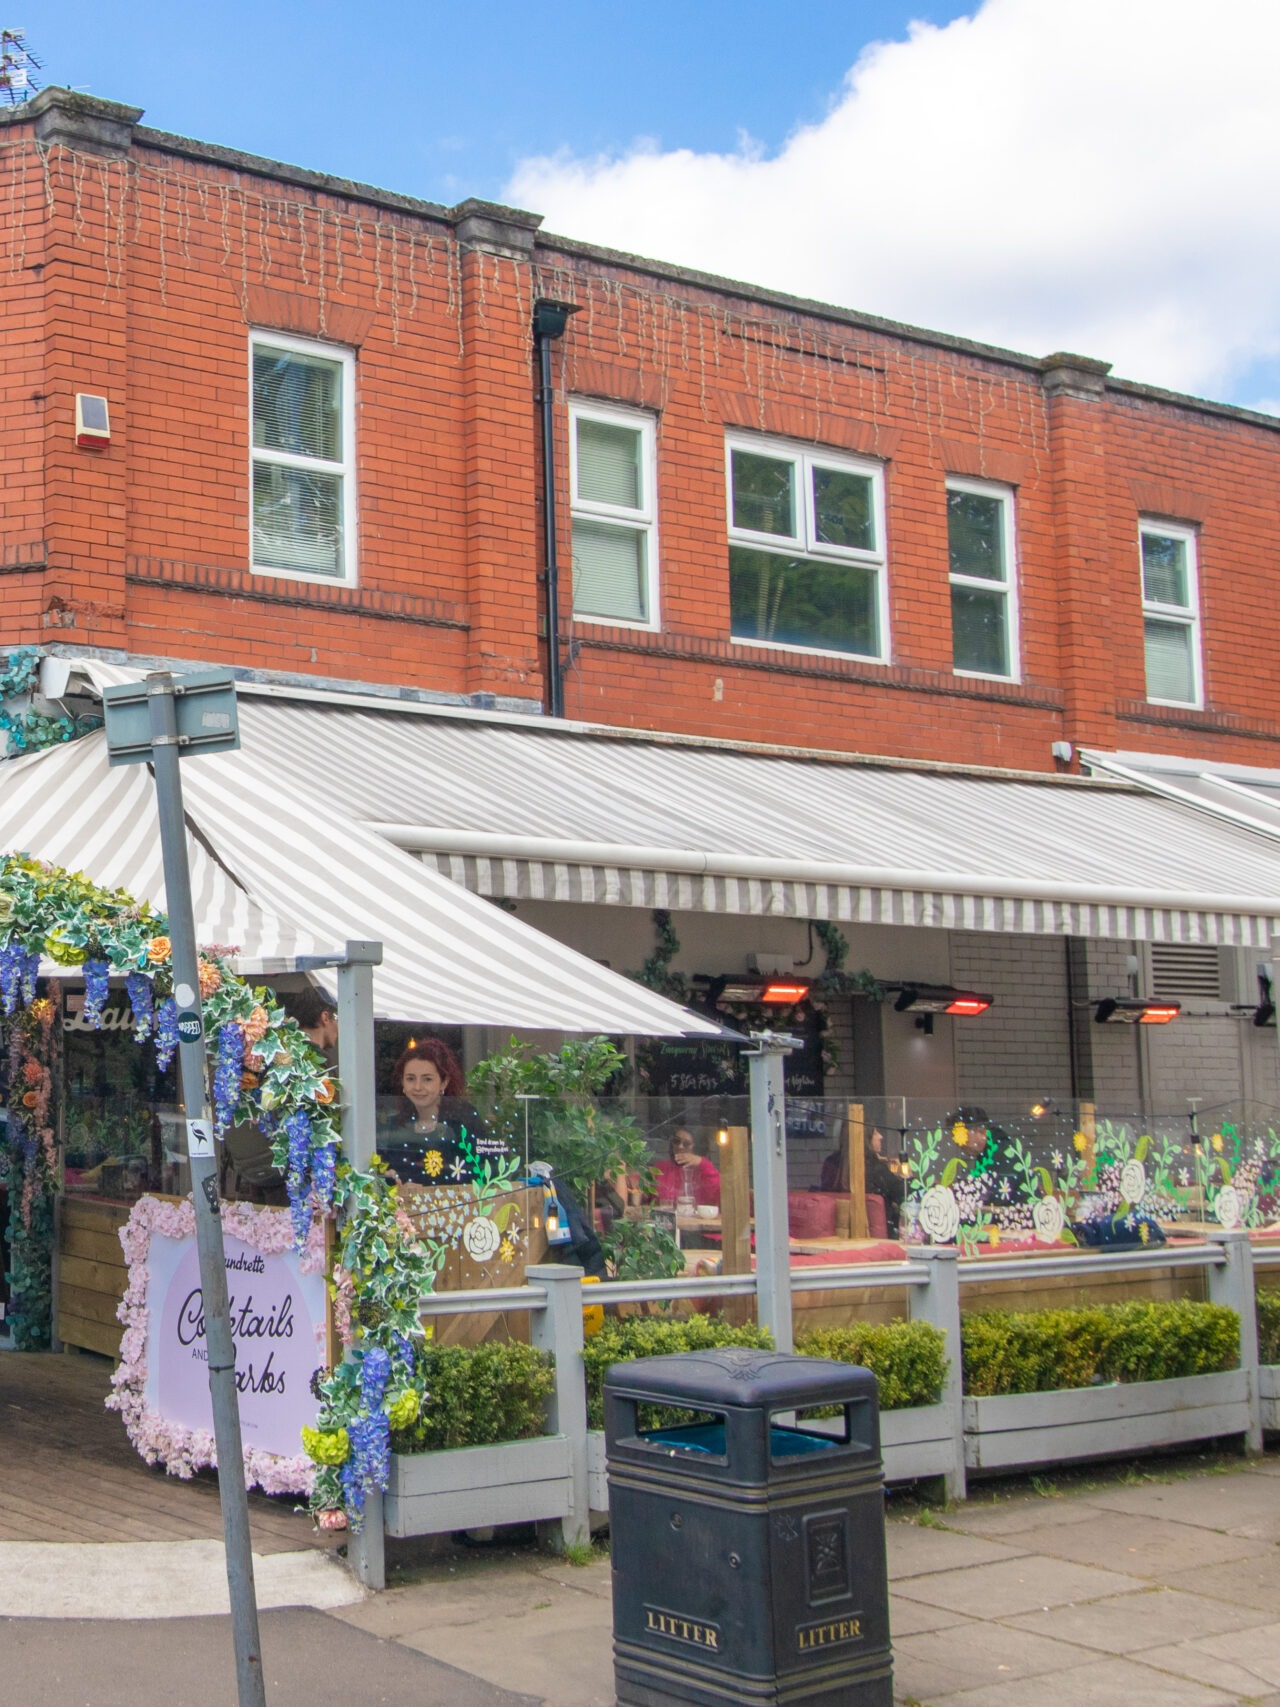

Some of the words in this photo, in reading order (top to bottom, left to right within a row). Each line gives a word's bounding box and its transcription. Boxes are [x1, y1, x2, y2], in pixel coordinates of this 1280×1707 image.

[224, 1252, 265, 1274] undrette
[177, 1288, 294, 1346] Coktails
[209, 1342, 286, 1394] arbs
[647, 1611, 718, 1648] LITTER
[798, 1619, 861, 1649] LITTER
